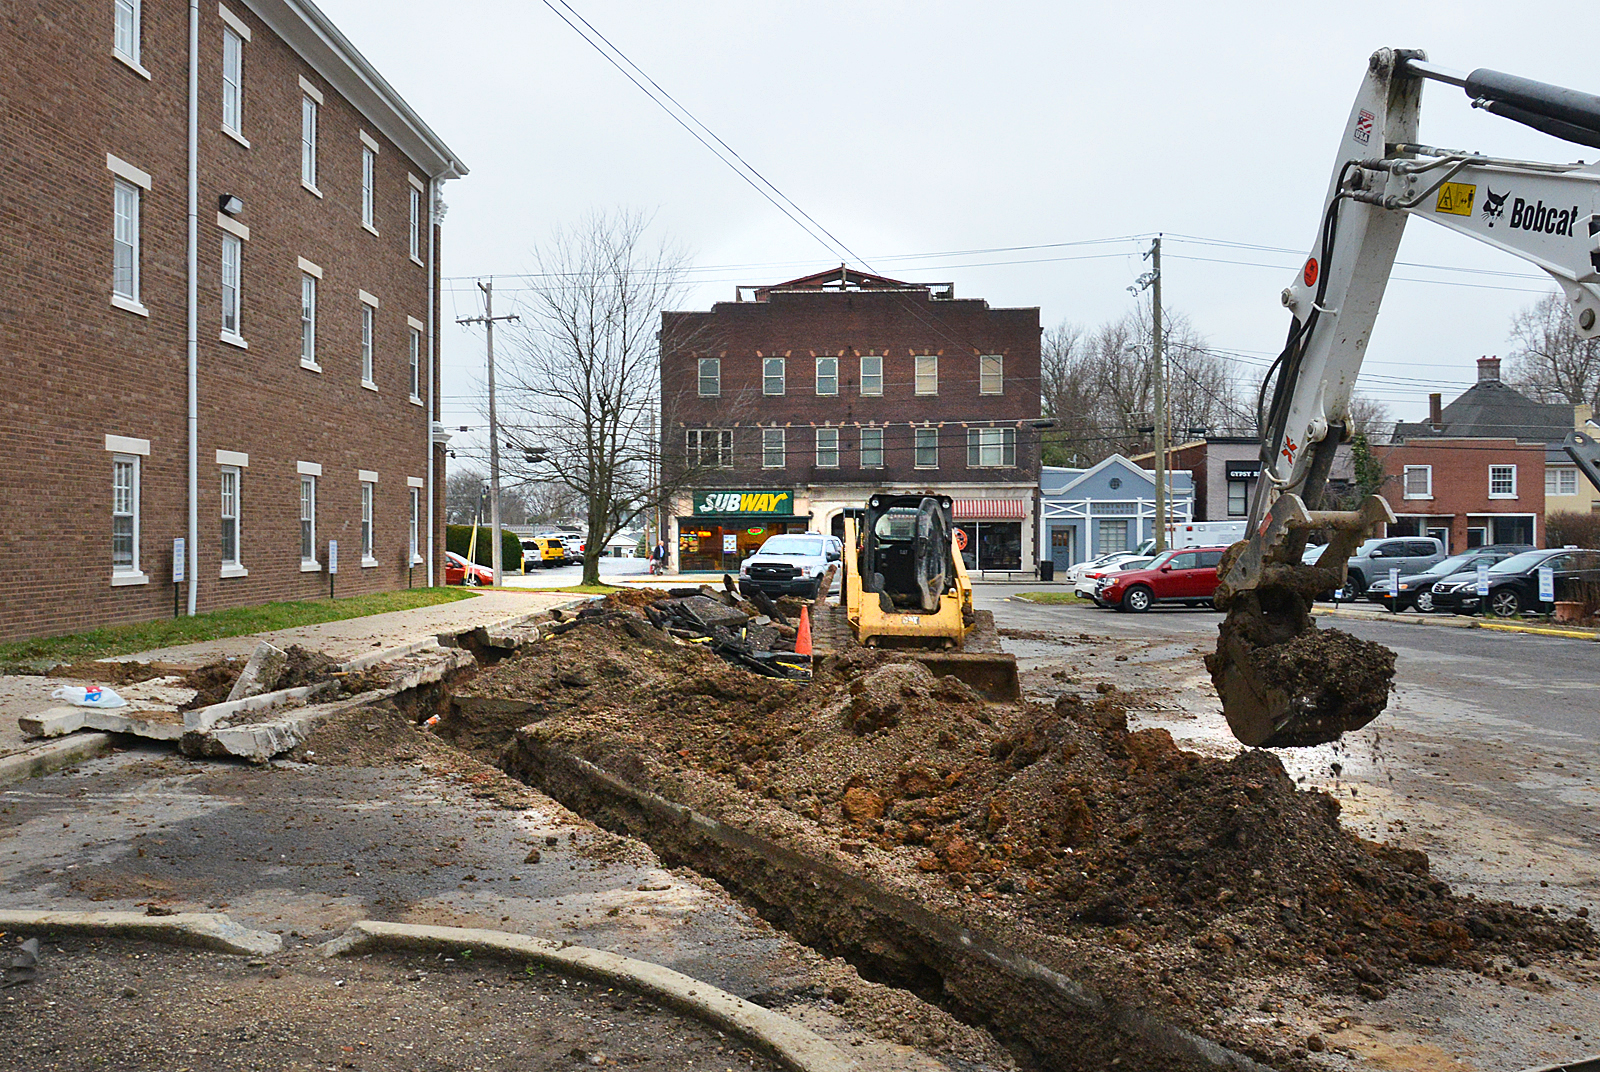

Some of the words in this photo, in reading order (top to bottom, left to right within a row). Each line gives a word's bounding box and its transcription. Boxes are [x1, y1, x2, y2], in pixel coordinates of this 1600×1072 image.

[1355, 130, 1369, 142] USA
[1509, 197, 1578, 237] Bobcat
[699, 492, 788, 512] SUBWAY
